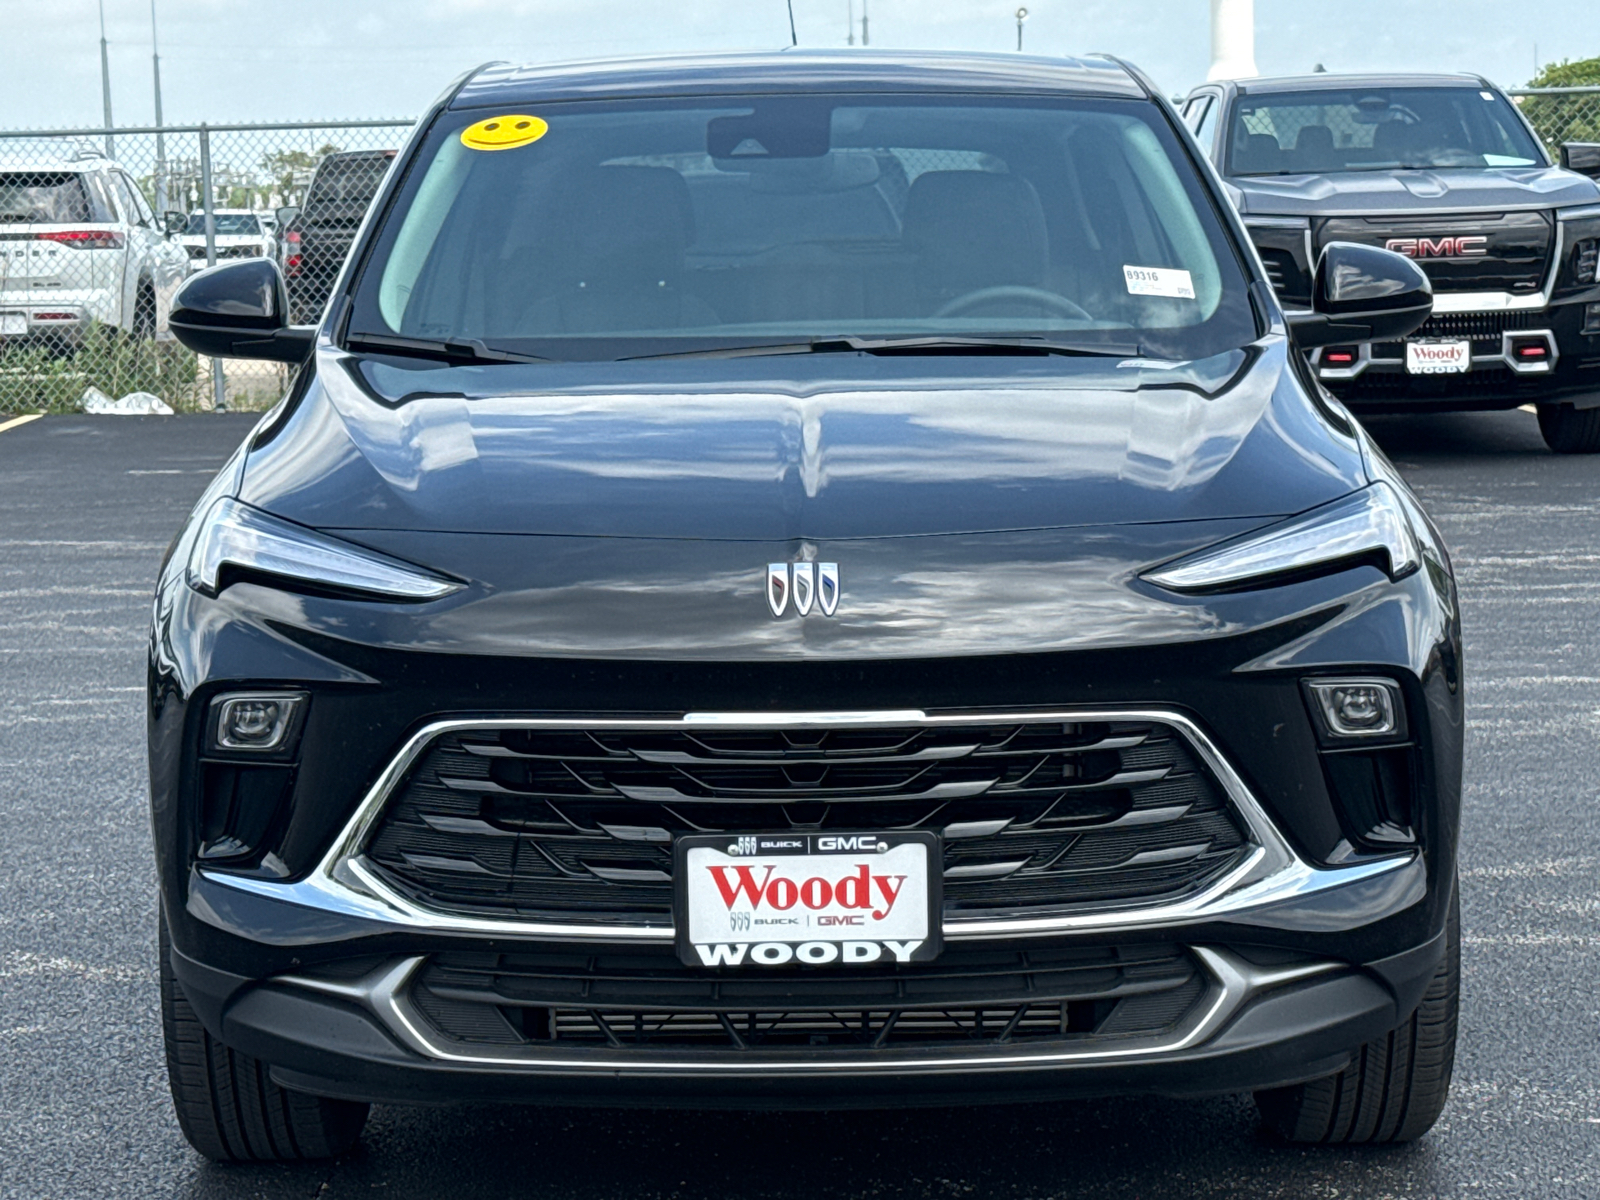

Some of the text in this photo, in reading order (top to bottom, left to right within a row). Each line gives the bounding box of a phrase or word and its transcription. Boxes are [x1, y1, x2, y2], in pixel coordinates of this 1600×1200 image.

[1385, 236, 1487, 257] GMC
[1412, 346, 1464, 362] Woody
[1408, 366, 1466, 375] WOODY
[760, 836, 877, 851] BUICK GMC
[705, 864, 908, 921] Woody
[753, 915, 865, 926] BUICK GMC
[694, 940, 924, 967] WOODY
